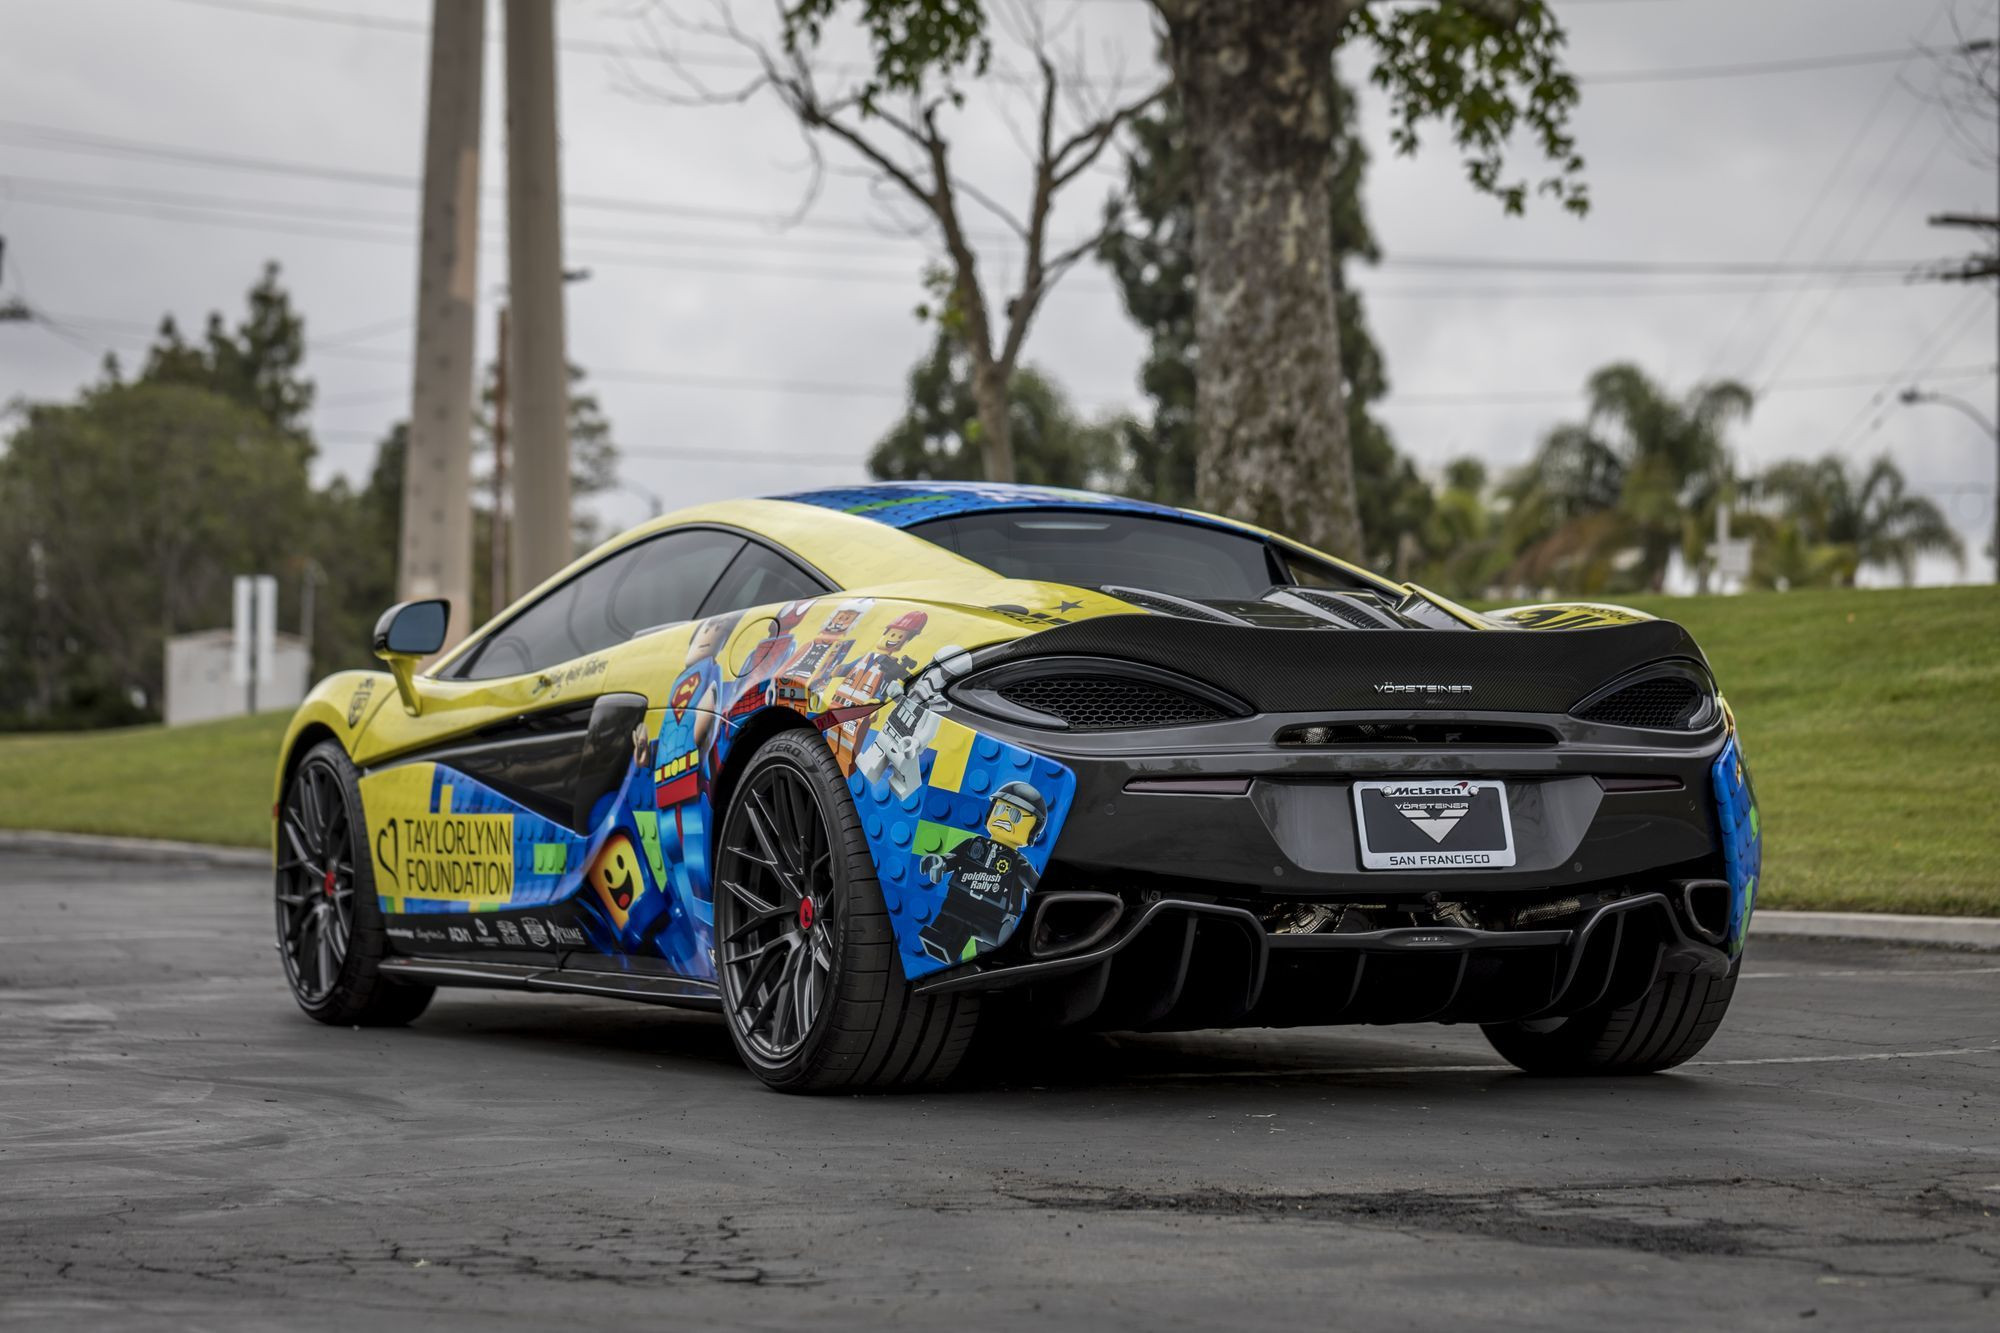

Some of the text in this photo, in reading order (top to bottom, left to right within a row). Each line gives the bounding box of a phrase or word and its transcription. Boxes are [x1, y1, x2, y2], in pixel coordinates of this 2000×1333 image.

[1374, 681, 1473, 694] VÖRSTEINER
[1391, 786, 1462, 796] McLaren
[1394, 802, 1470, 810] VÖRSTEINER
[404, 819, 511, 855] TAYLORLYNN
[1389, 854, 1490, 866] SAN FRANCISCO
[406, 858, 511, 895] FOUNDATION
[961, 872, 1001, 883] goldRush
[970, 880, 993, 892] Rally
